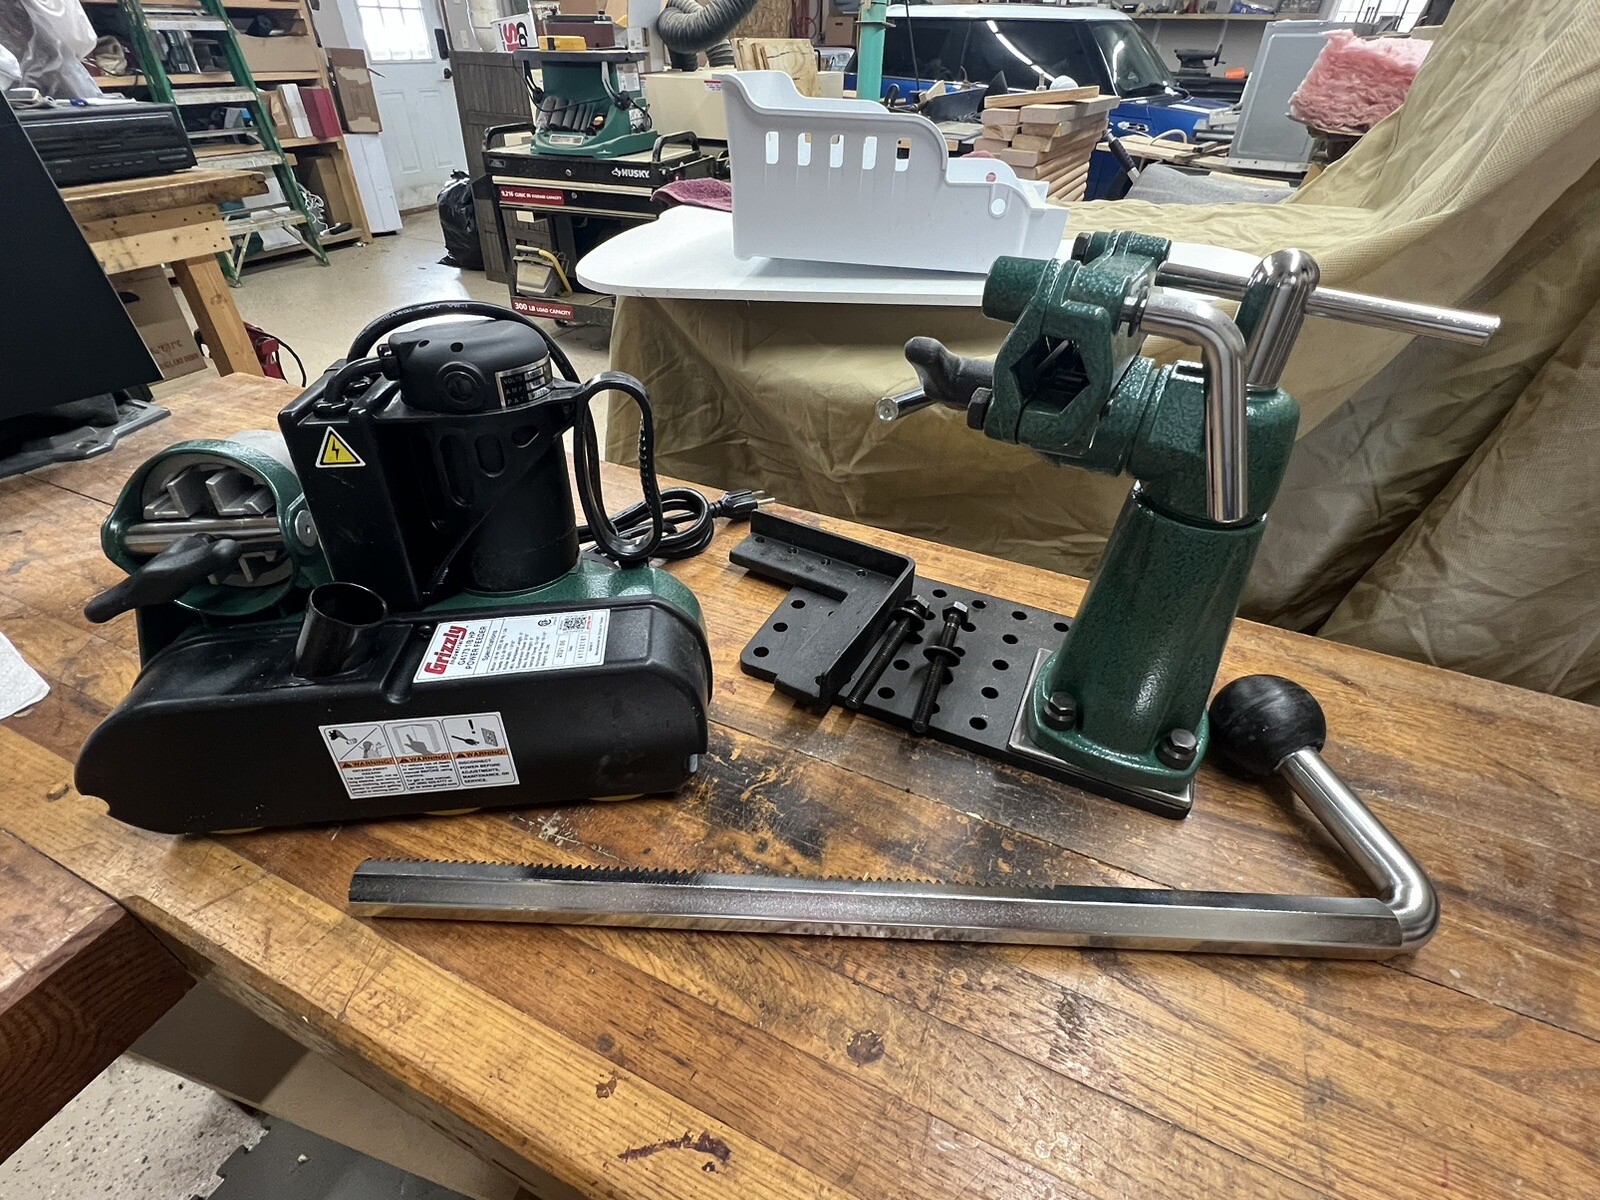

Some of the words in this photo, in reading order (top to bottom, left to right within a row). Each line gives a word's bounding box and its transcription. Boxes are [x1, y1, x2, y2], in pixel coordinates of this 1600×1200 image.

[621, 168, 650, 178] HUSKY
[514, 301, 528, 311] 300
[549, 308, 572, 316] CAPACITY
[424, 625, 468, 675] Grizzly
[465, 648, 479, 670] POWER
[474, 625, 487, 648] FEEDER
[458, 648, 471, 666] G4173
[466, 749, 506, 757] WARNING!
